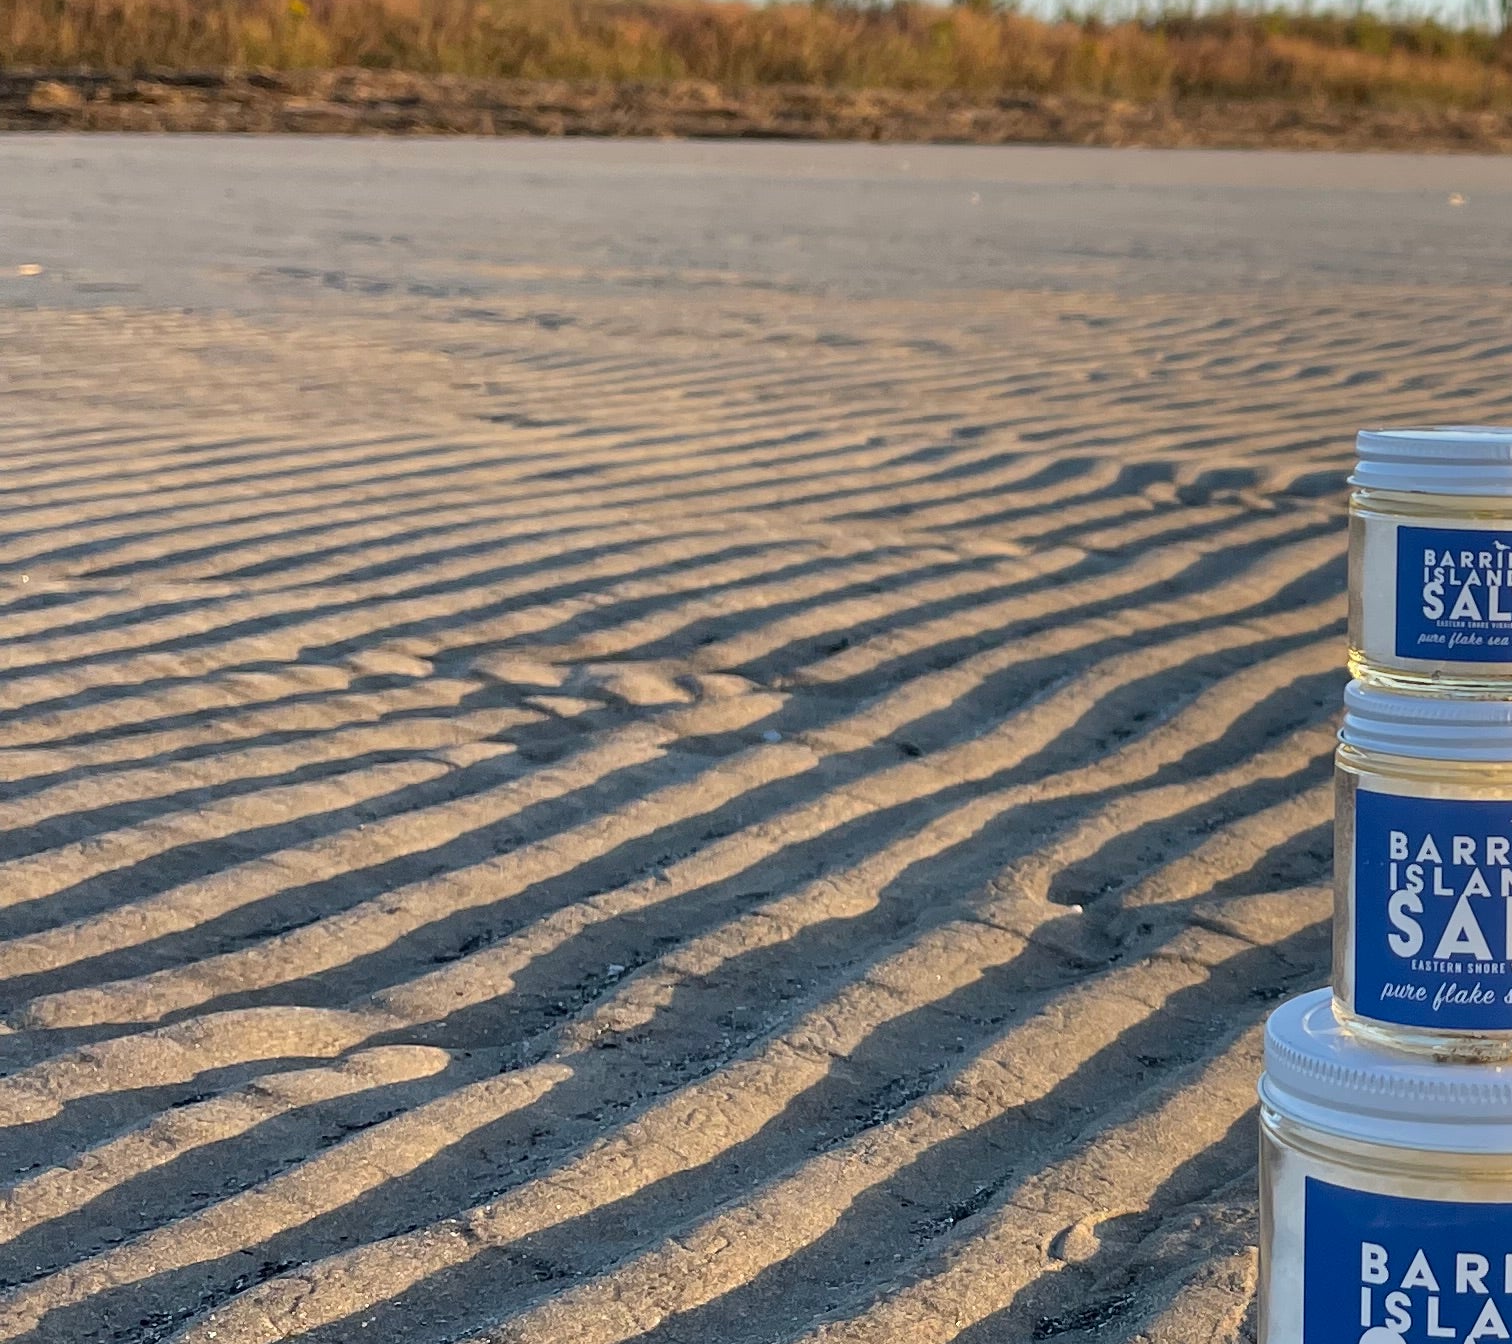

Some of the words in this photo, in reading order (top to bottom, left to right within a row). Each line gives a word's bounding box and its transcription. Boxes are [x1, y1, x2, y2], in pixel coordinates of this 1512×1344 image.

[1416, 632, 1446, 644] pure
[1448, 632, 1483, 649] flake
[1487, 635, 1510, 646] sea
[1411, 959, 1462, 974] EASTERN
[1467, 962, 1506, 974] SHORE
[1380, 981, 1428, 1001] pure
[1432, 981, 1496, 1012] flake
